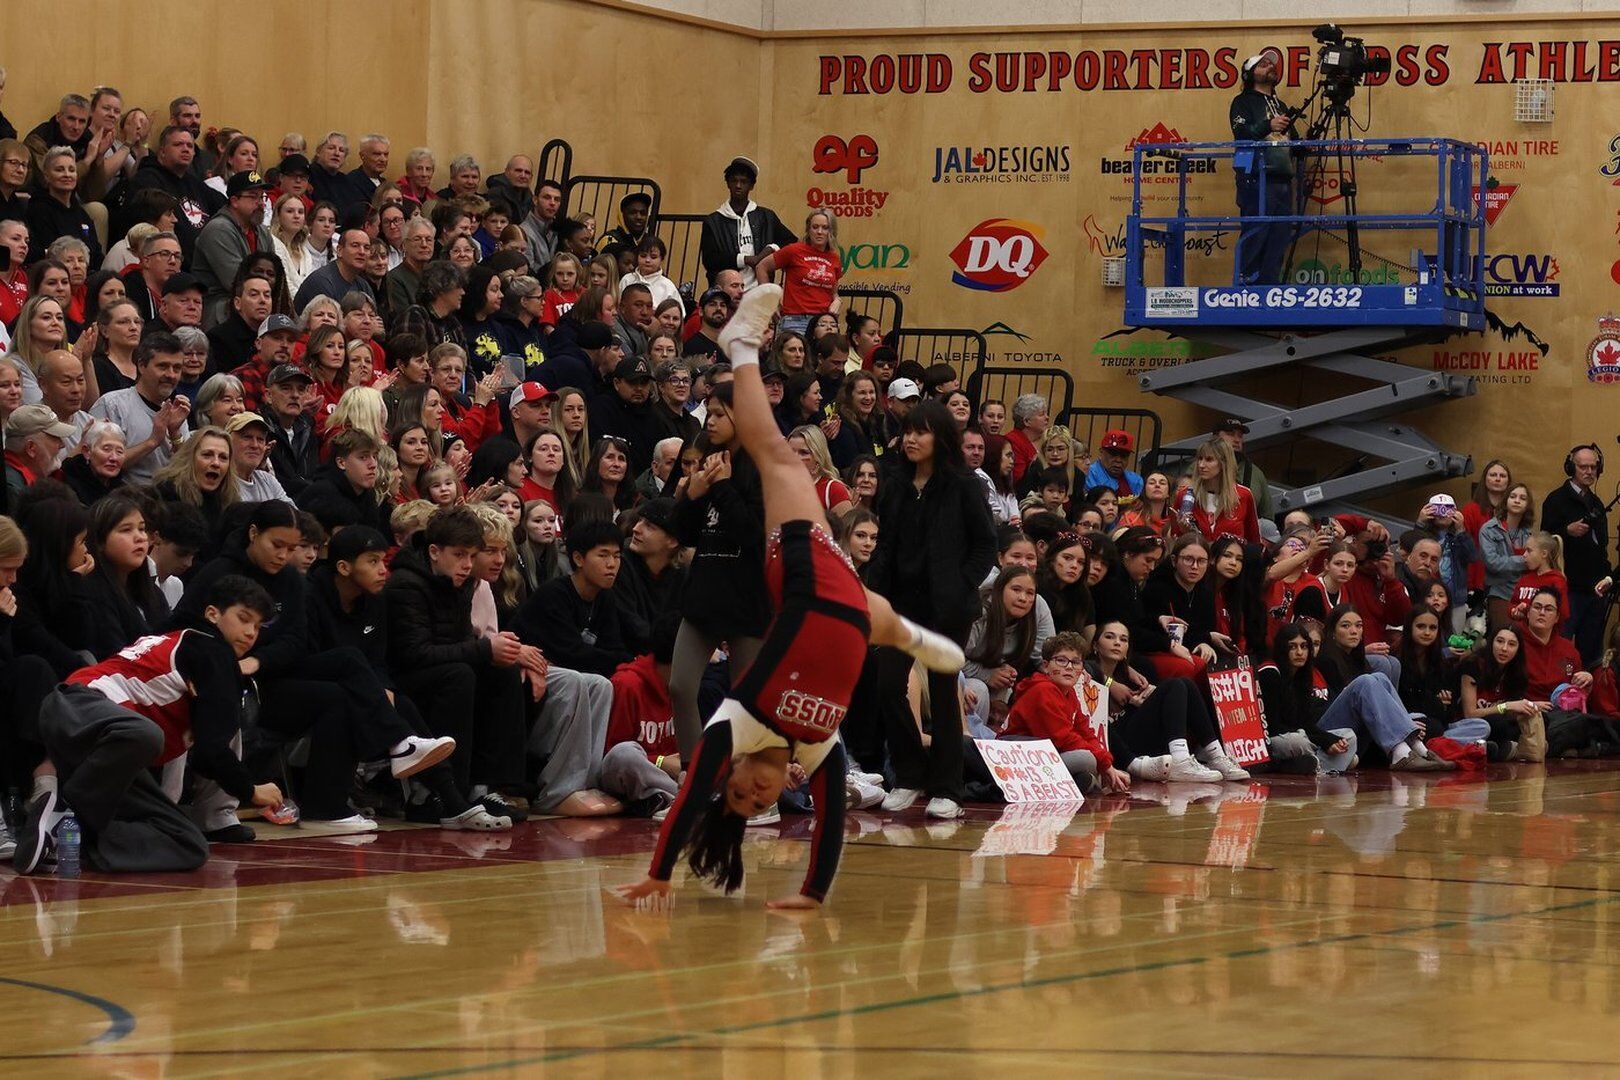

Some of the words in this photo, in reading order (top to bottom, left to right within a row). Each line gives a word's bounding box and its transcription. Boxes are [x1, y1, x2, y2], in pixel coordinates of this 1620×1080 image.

[818, 53, 953, 95] PROUD
[968, 46, 1239, 93] SUPPORTERS
[1357, 44, 1450, 87] DSS
[1474, 40, 1620, 84] ATHLE
[1523, 141, 1559, 155] TIRE
[944, 175, 951, 183] &
[956, 174, 1012, 183] GRAPHICS
[807, 187, 889, 209] Quality
[827, 206, 873, 218] OODS
[1185, 222, 1230, 256] oast
[838, 243, 910, 275] yan
[963, 235, 1035, 277] DQ
[1470, 254, 1550, 283] FCW
[838, 281, 868, 291] onsible
[872, 281, 911, 294] Vending
[1484, 285, 1511, 295] NION
[1512, 286, 1523, 294] at
[1526, 285, 1553, 294] work
[1204, 288, 1260, 308] Genie
[1266, 287, 1363, 308] GS-2632
[1004, 352, 1063, 362] TOYOTA
[1101, 358, 1137, 367] TRUCK
[1433, 352, 1491, 371] McCOY
[1498, 352, 1539, 371] LAKE
[1474, 375, 1508, 384] ATING
[1512, 375, 1532, 384] LTD
[1001, 783, 1020, 801] IS
[1021, 783, 1034, 801] A
[1030, 780, 1079, 801] BEAST
